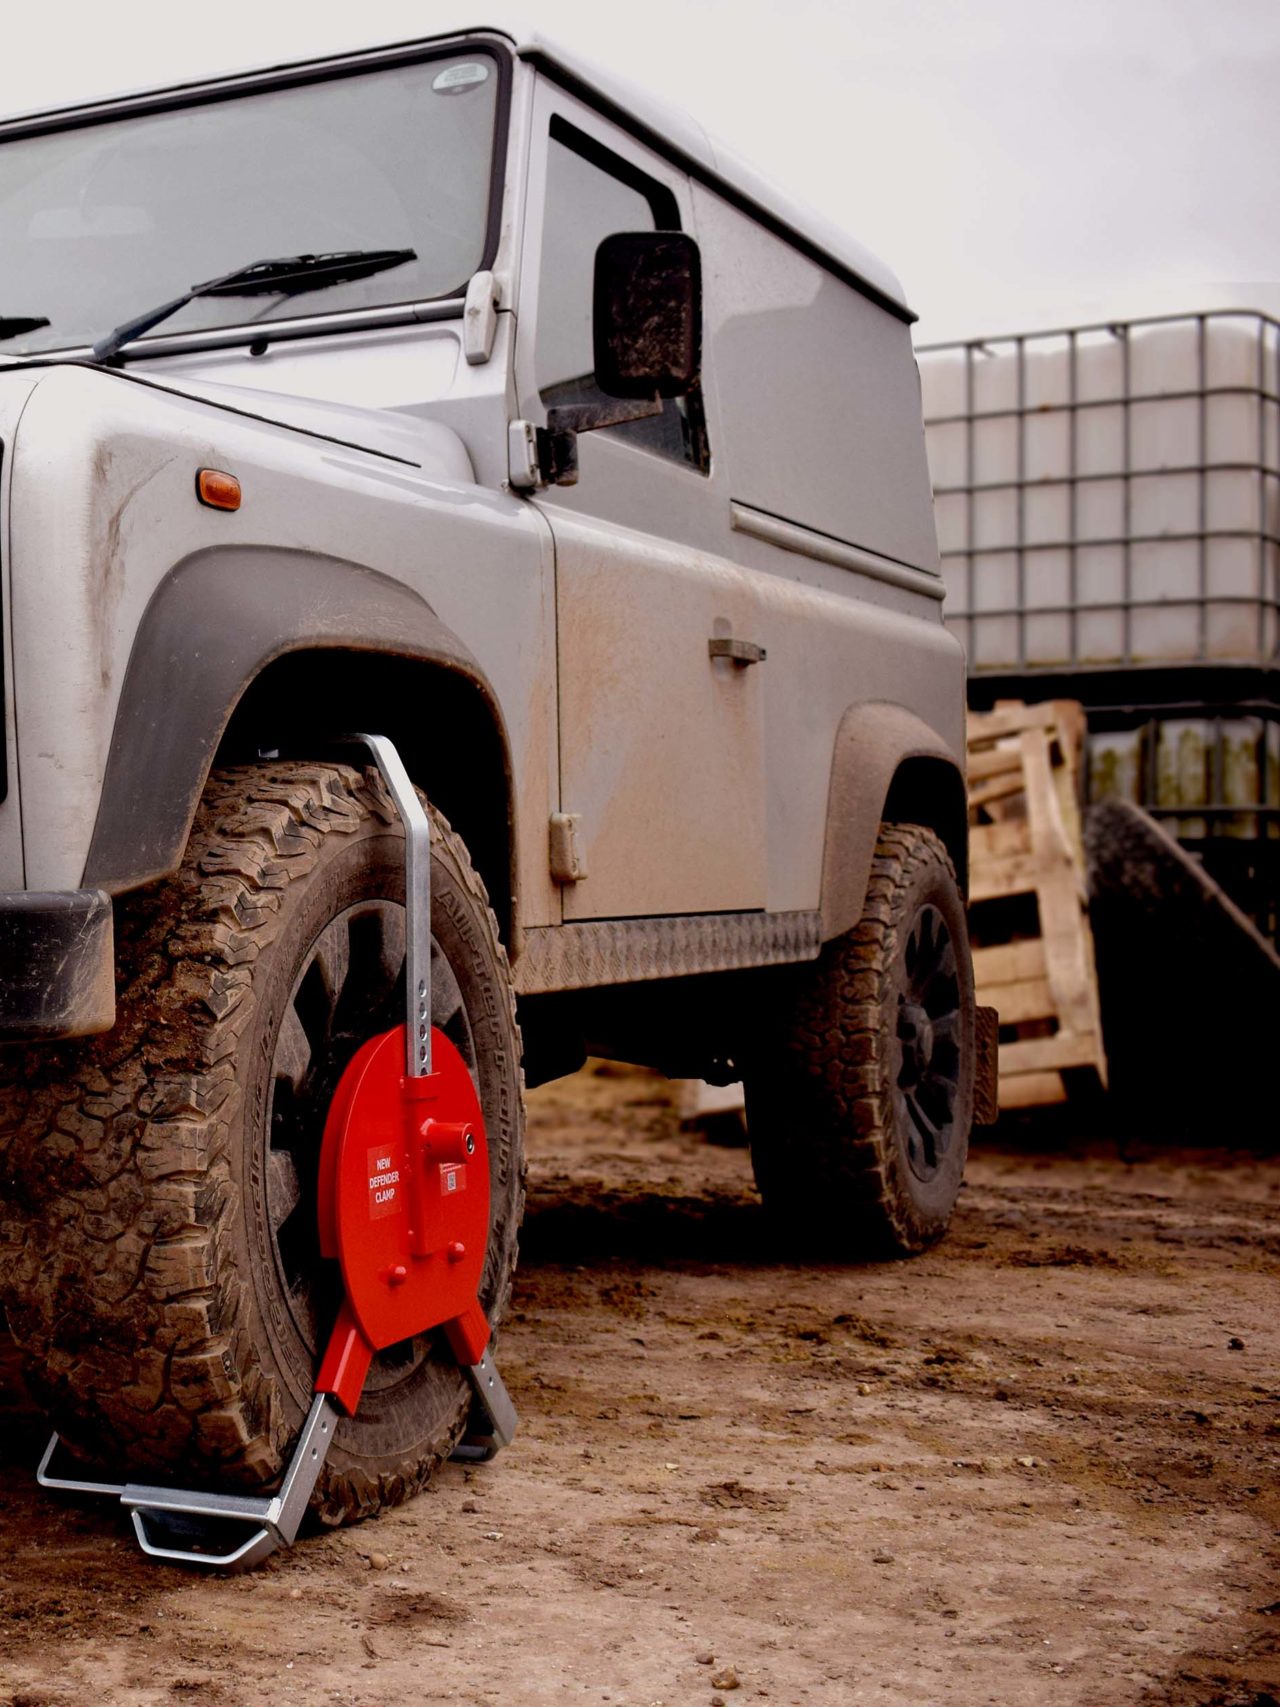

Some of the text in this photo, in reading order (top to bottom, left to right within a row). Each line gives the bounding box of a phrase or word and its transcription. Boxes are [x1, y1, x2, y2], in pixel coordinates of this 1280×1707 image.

[376, 1157, 391, 1171] NEW
[369, 1171, 400, 1189] DEFENDER
[375, 1188, 395, 1203] CLAMP
